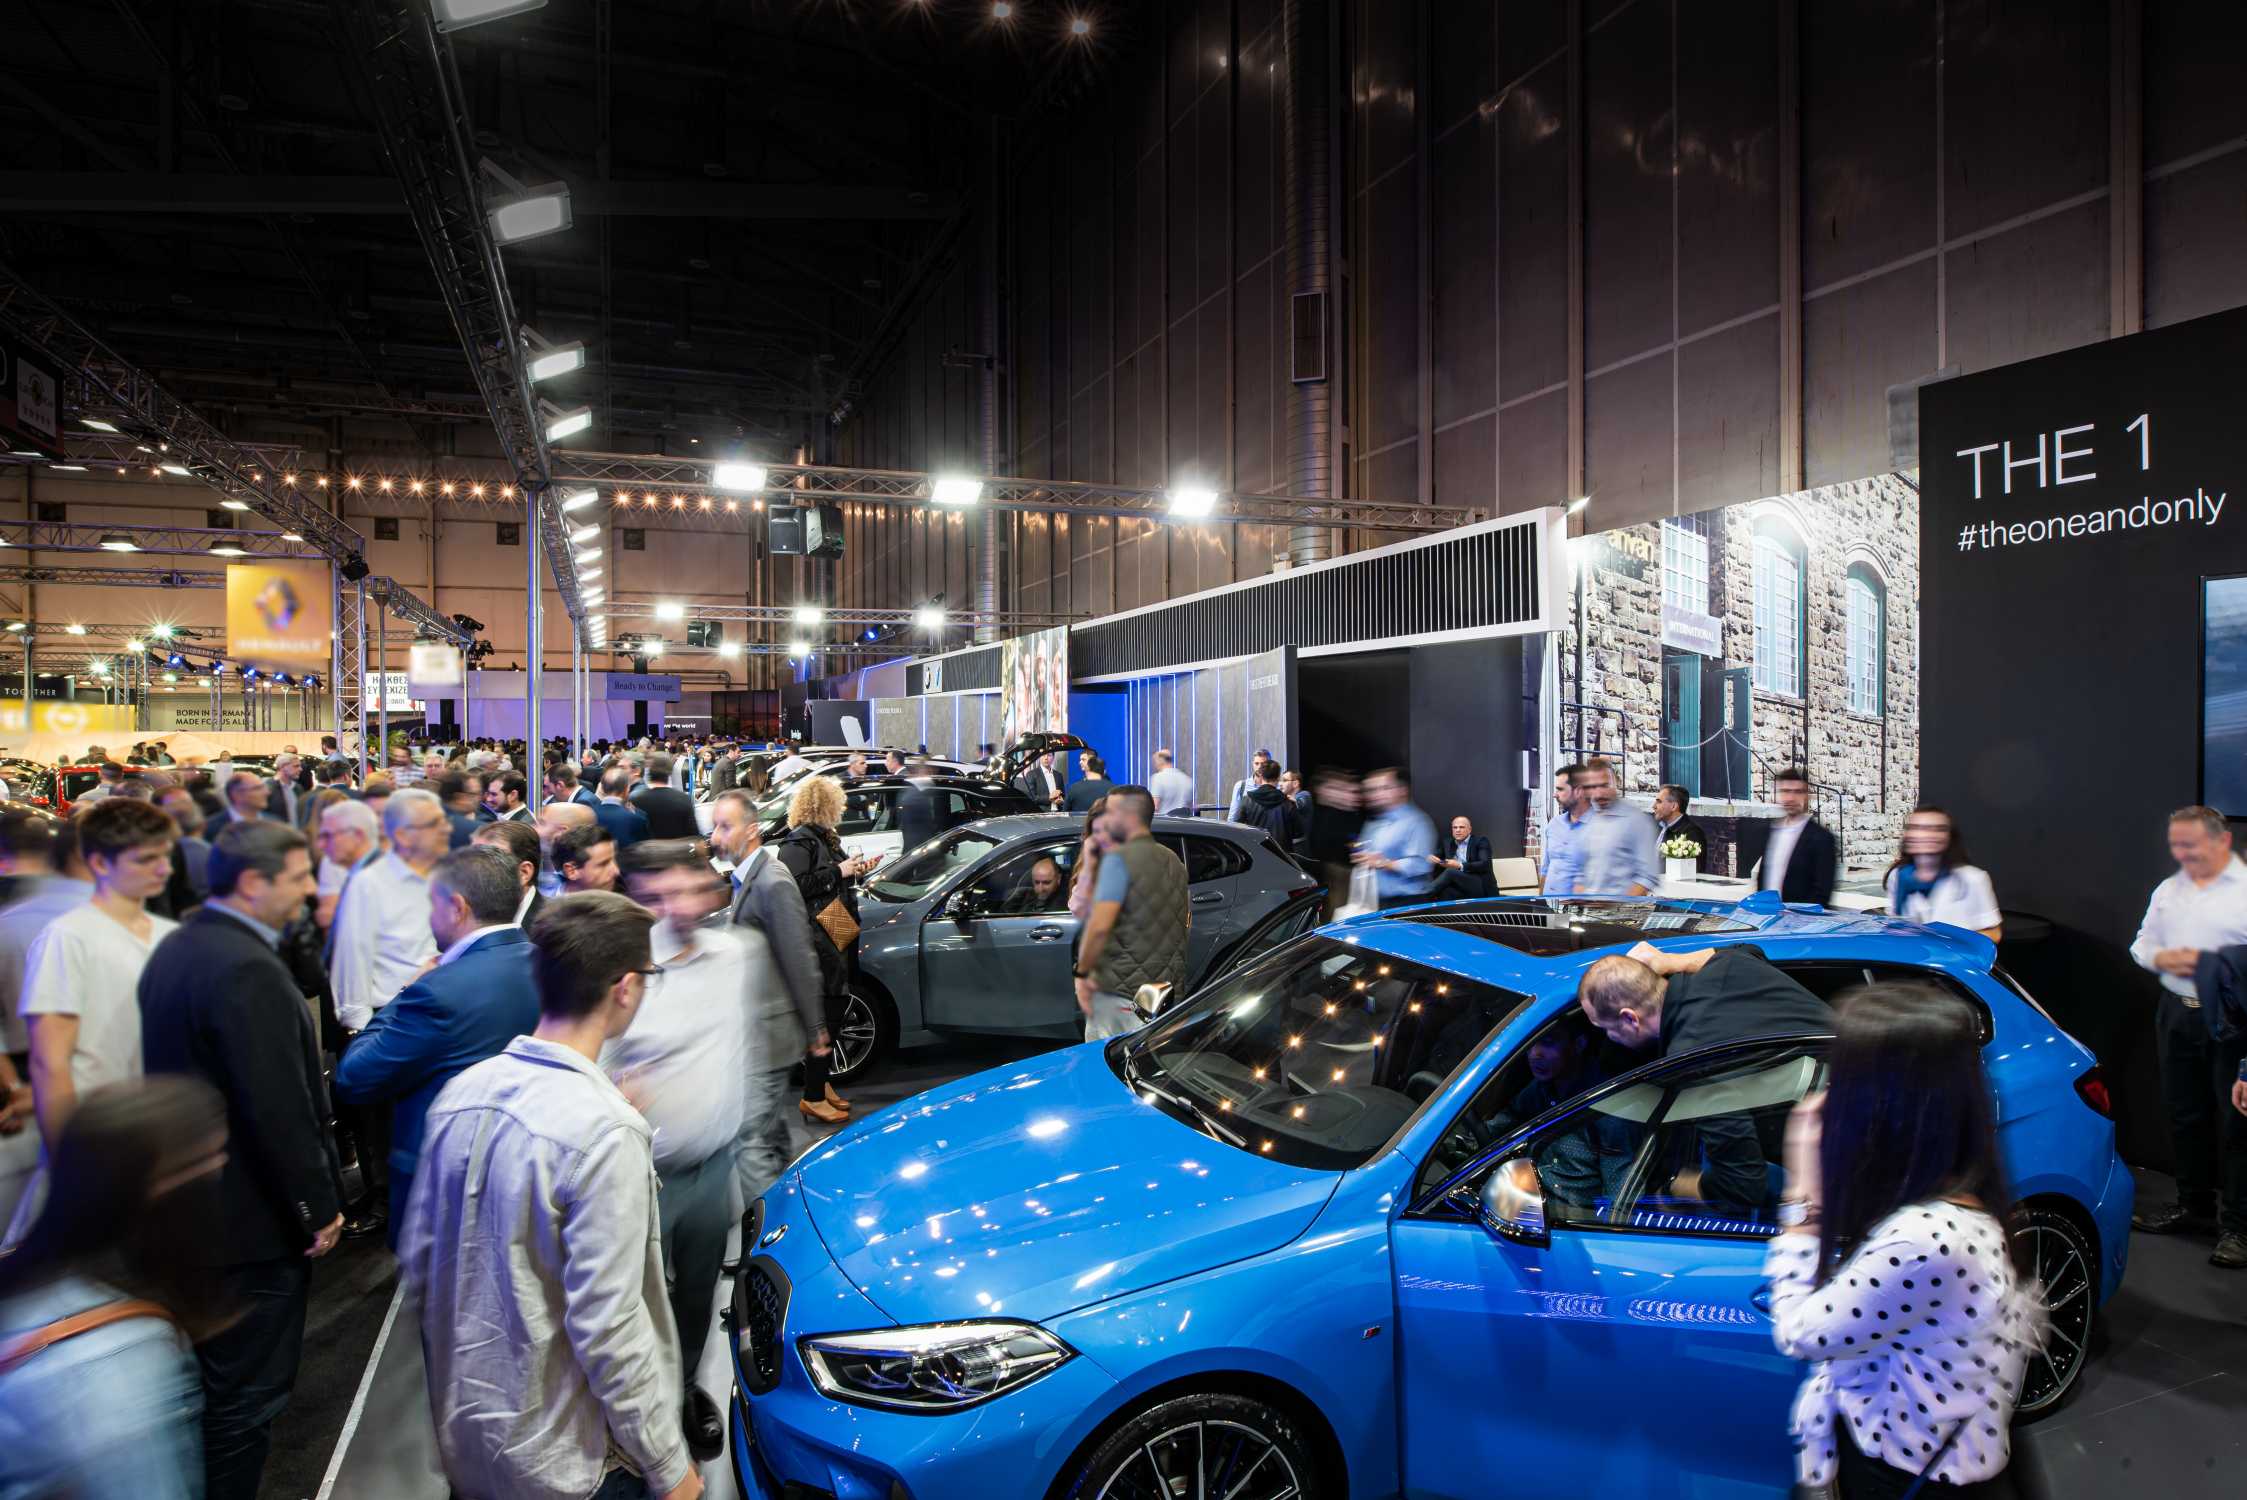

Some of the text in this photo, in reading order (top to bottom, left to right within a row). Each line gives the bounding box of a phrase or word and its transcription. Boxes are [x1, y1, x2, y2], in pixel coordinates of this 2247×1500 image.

[1957, 413, 2149, 499] THE 1
[1957, 487, 2227, 551] #theoneandonly
[614, 681, 636, 691] Ready
[176, 709, 200, 717] BORN
[201, 709, 210, 717] IN
[176, 718, 200, 726] MADE
